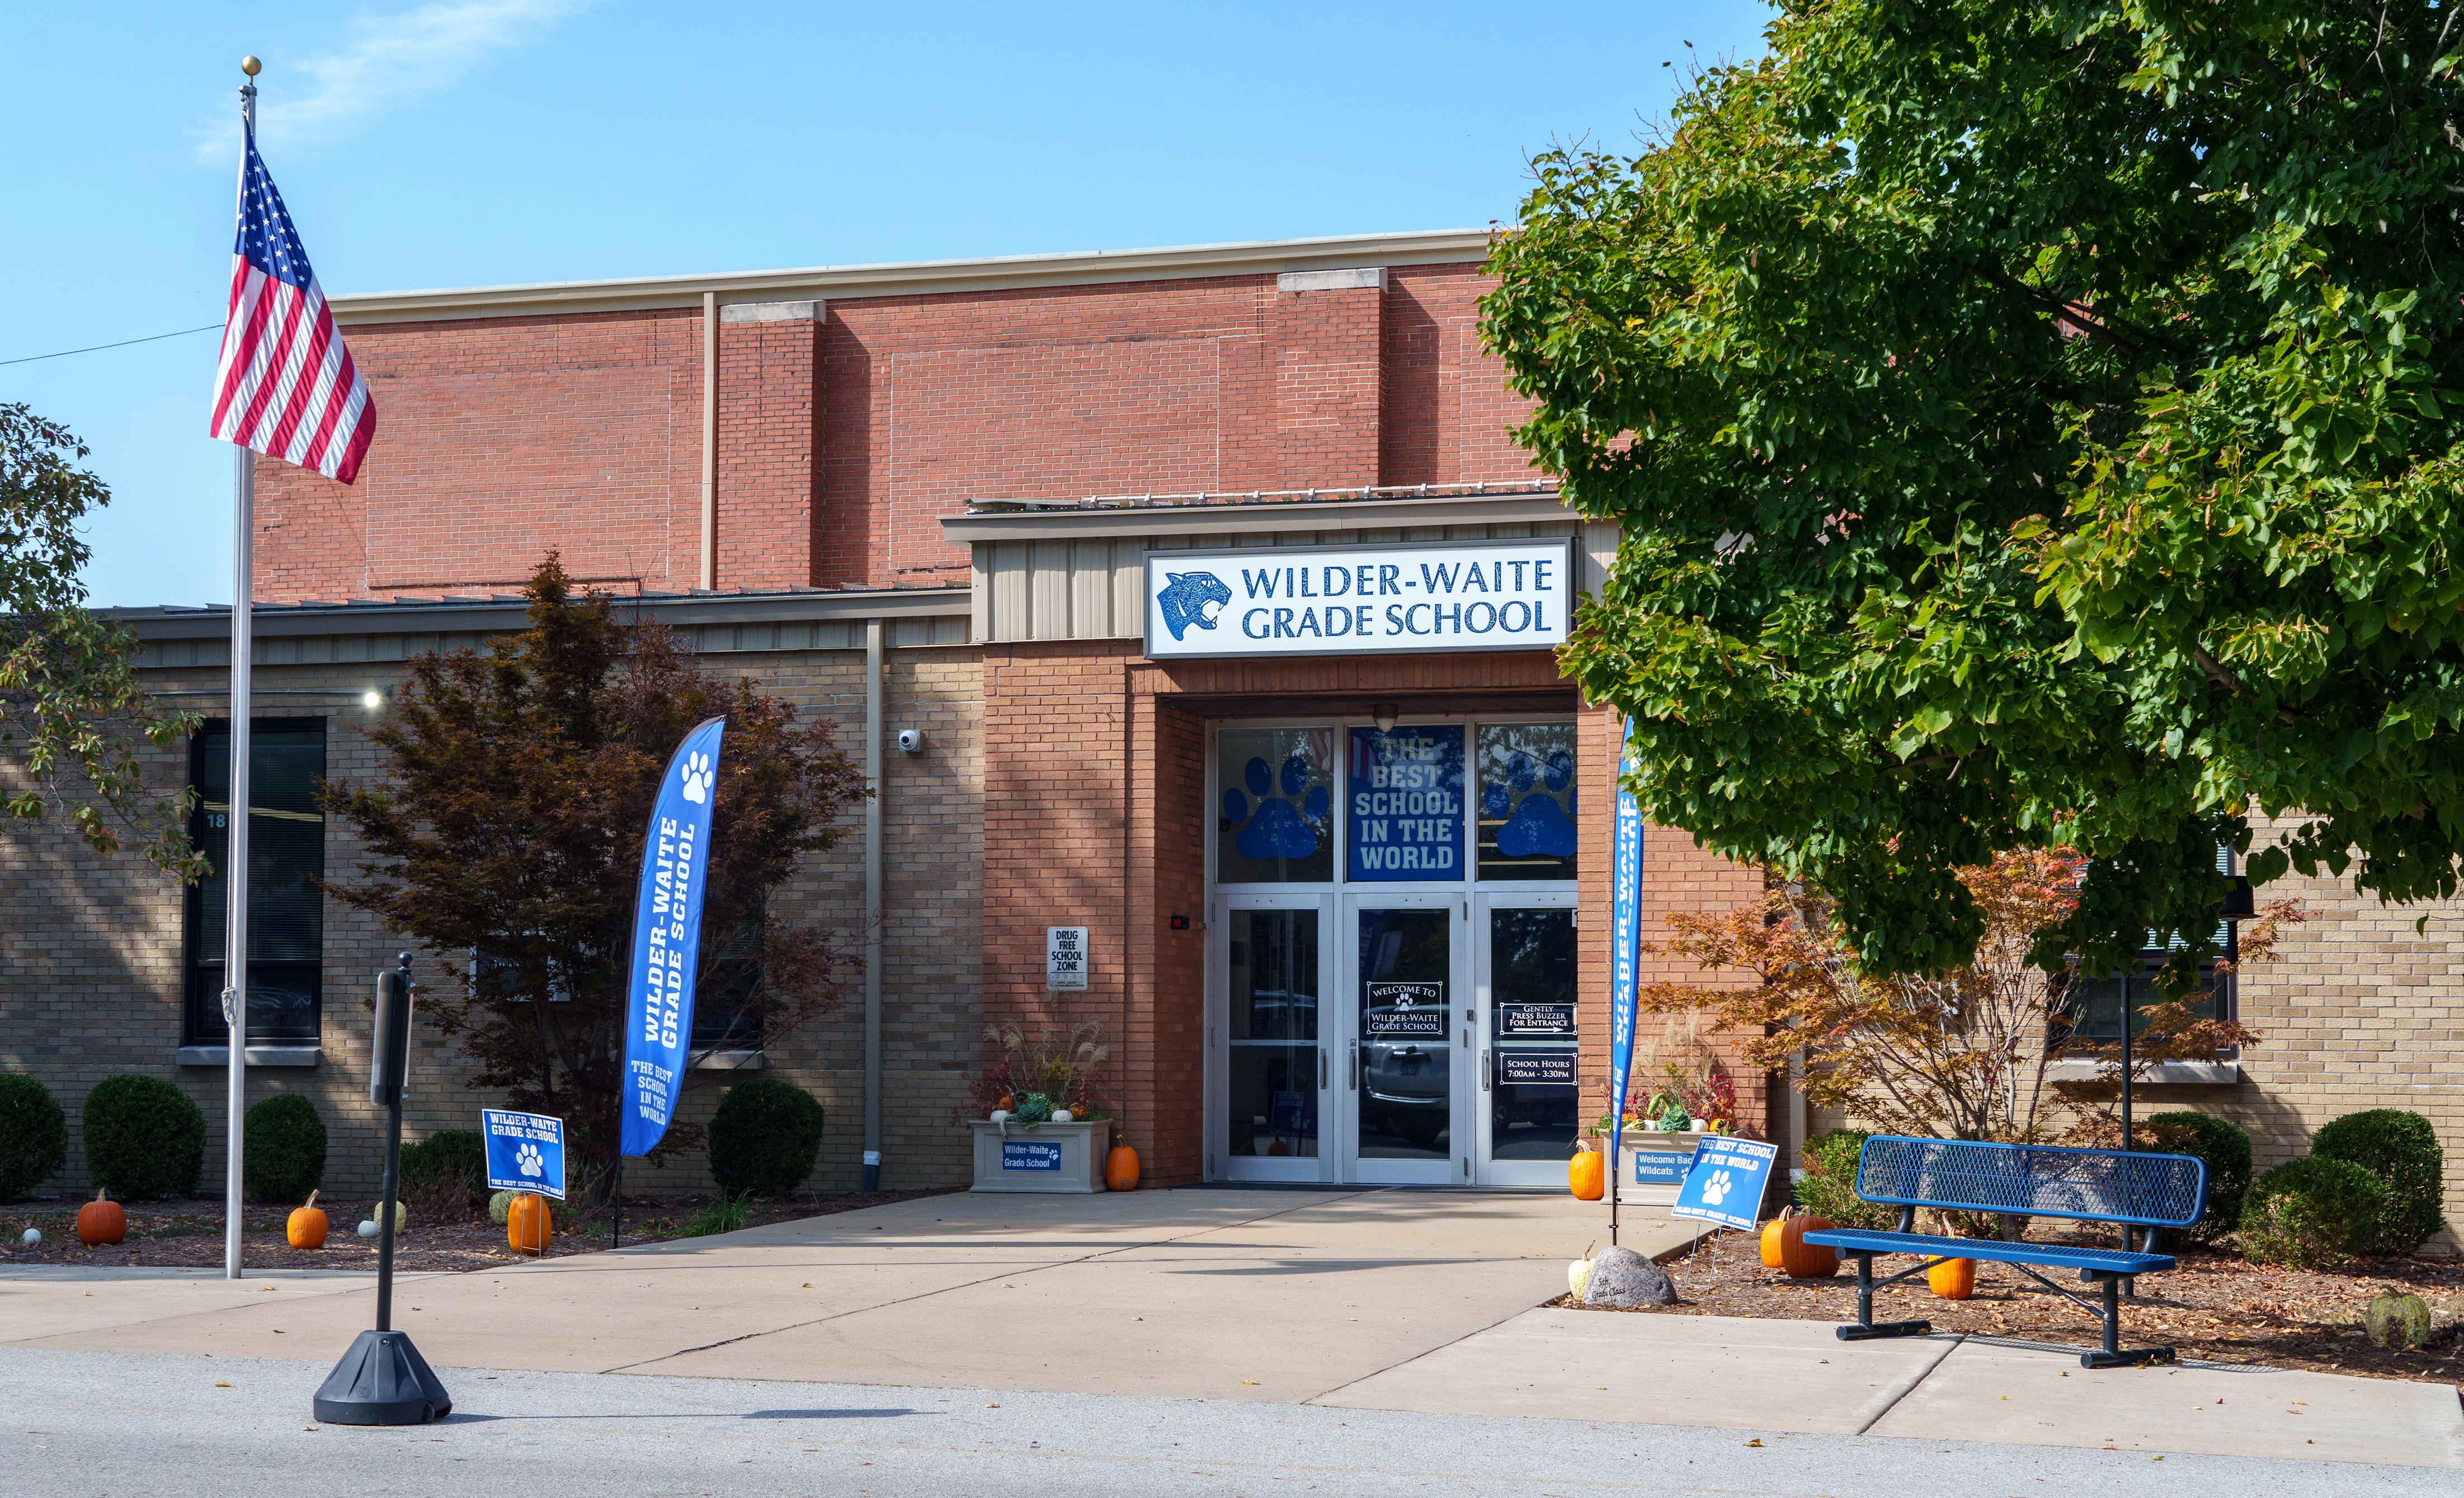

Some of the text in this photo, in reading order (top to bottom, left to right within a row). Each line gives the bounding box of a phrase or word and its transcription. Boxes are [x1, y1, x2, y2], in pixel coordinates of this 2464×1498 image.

[1241, 560, 1552, 599] WILDER-WAITE
[1242, 601, 1552, 639] GRADE SCHOOL
[1380, 738, 1434, 761] THE
[1372, 765, 1441, 788] BEST
[1355, 792, 1458, 816] SCHOOL
[208, 814, 225, 828] 18
[1361, 819, 1452, 842] IN THE
[1360, 846, 1453, 869] WORLD
[645, 817, 677, 1042] WILDER-WAITE
[661, 823, 695, 1049] GRADE SCHOOL
[1056, 931, 1078, 940] DRUG
[1059, 940, 1076, 950] FREE
[1052, 951, 1082, 960] SCHOOL
[1057, 962, 1077, 971] ZONE
[1373, 985, 1436, 997] WELCOME TO
[631, 1060, 672, 1084] THE BEST
[638, 1076, 667, 1097] SCHOOL
[640, 1091, 666, 1111] IN THE
[489, 1113, 557, 1132] WILDER-WAITE
[639, 1105, 665, 1125] WORLD
[491, 1124, 558, 1144] GRADE SCHOOL
[1005, 1145, 1048, 1154] Wilder-Waite
[1699, 1139, 1773, 1159] THE BEST SCHOOL
[1005, 1158, 1024, 1167] Grade
[1639, 1155, 1694, 1165] Welcome Bac
[1700, 1153, 1759, 1171] IN THE WORLD
[1639, 1166, 1673, 1175] Wildcats
[1706, 1209, 1727, 1221] GRADE
[1728, 1215, 1752, 1228] SCHOOL
[1599, 1276, 1609, 1286] 5th
[1592, 1287, 1626, 1302] Grade Class
